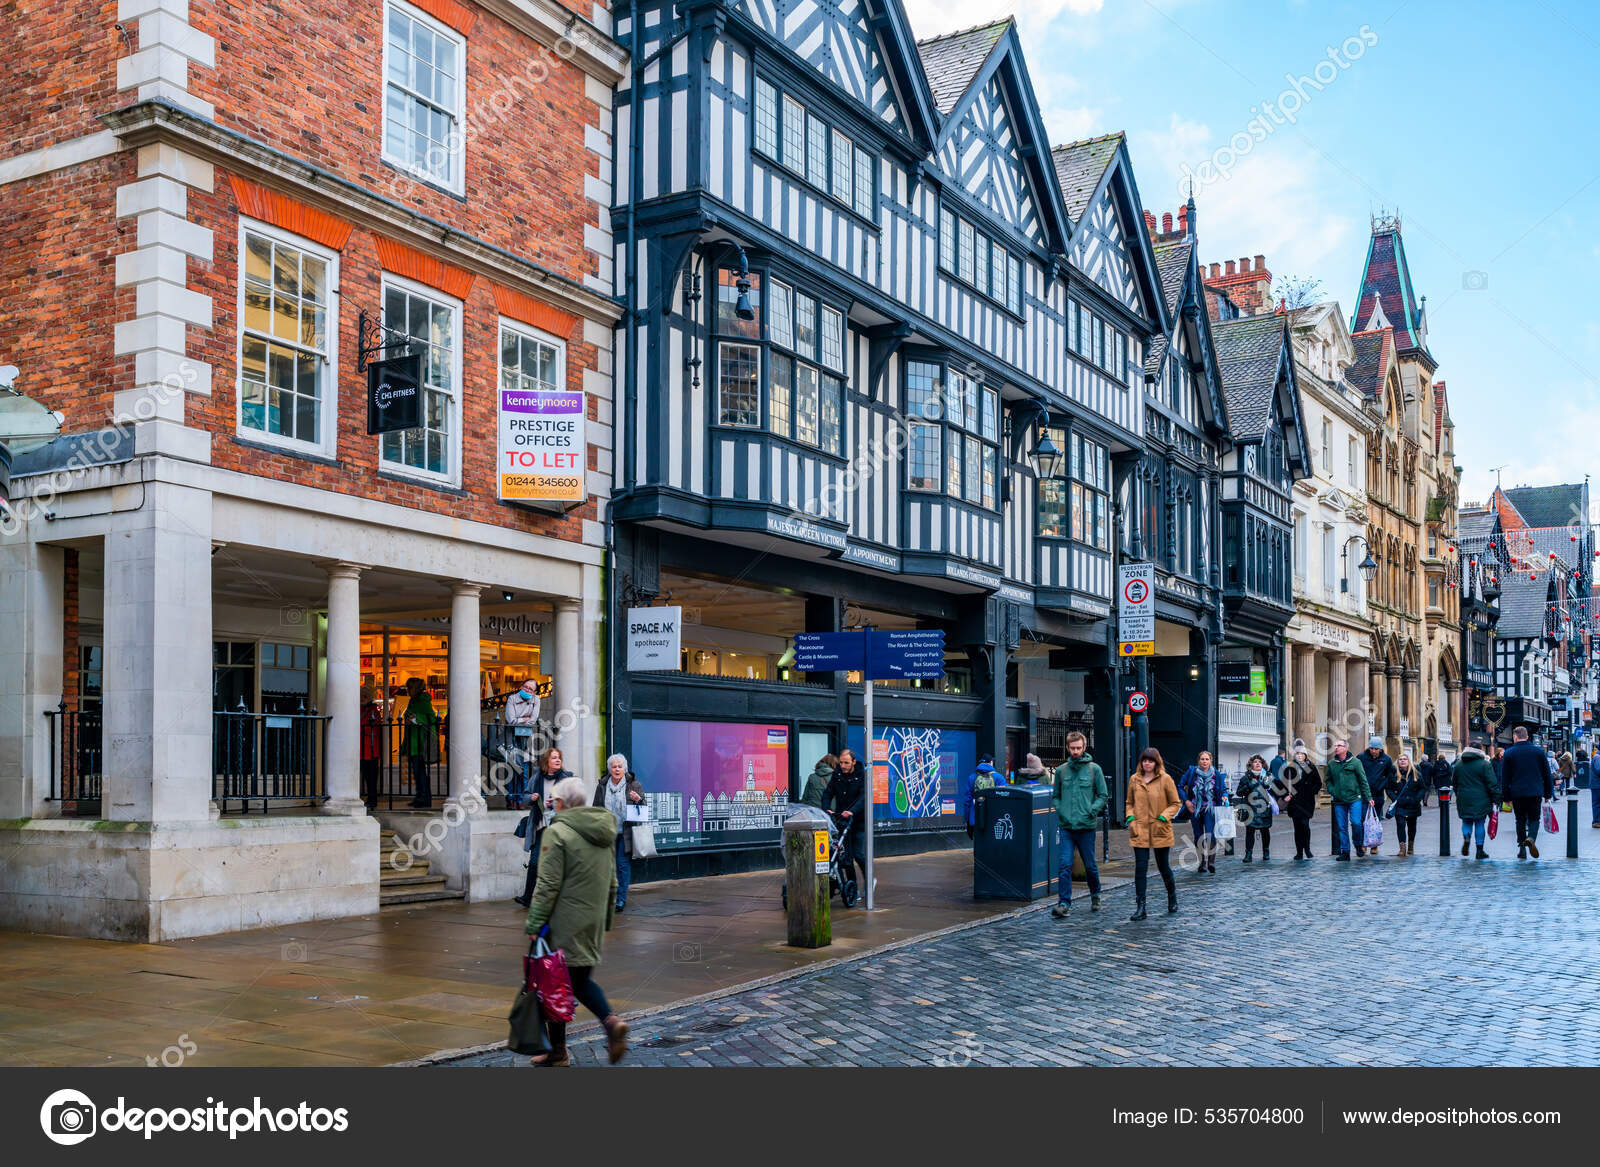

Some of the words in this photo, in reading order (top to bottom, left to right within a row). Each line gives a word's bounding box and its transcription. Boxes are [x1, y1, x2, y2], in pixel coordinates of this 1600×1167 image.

[393, 388, 415, 398] FITNESS
[507, 394, 578, 410] kenneymoore
[510, 420, 575, 432] PRESTIGE
[515, 435, 571, 446] OFFICES
[506, 451, 535, 467] TO
[543, 452, 579, 468] LET
[506, 477, 535, 486] 01244
[538, 477, 578, 488] 345600
[767, 518, 798, 537] MAJESTY
[799, 527, 820, 542] QUEEN
[820, 532, 846, 548] VICTORIA
[853, 548, 897, 567] APPOINTMENT
[1125, 570, 1147, 578] ZONE
[1311, 619, 1350, 643] DEBENHAMS
[635, 639, 670, 648] apothecary
[1132, 698, 1145, 706] 20
